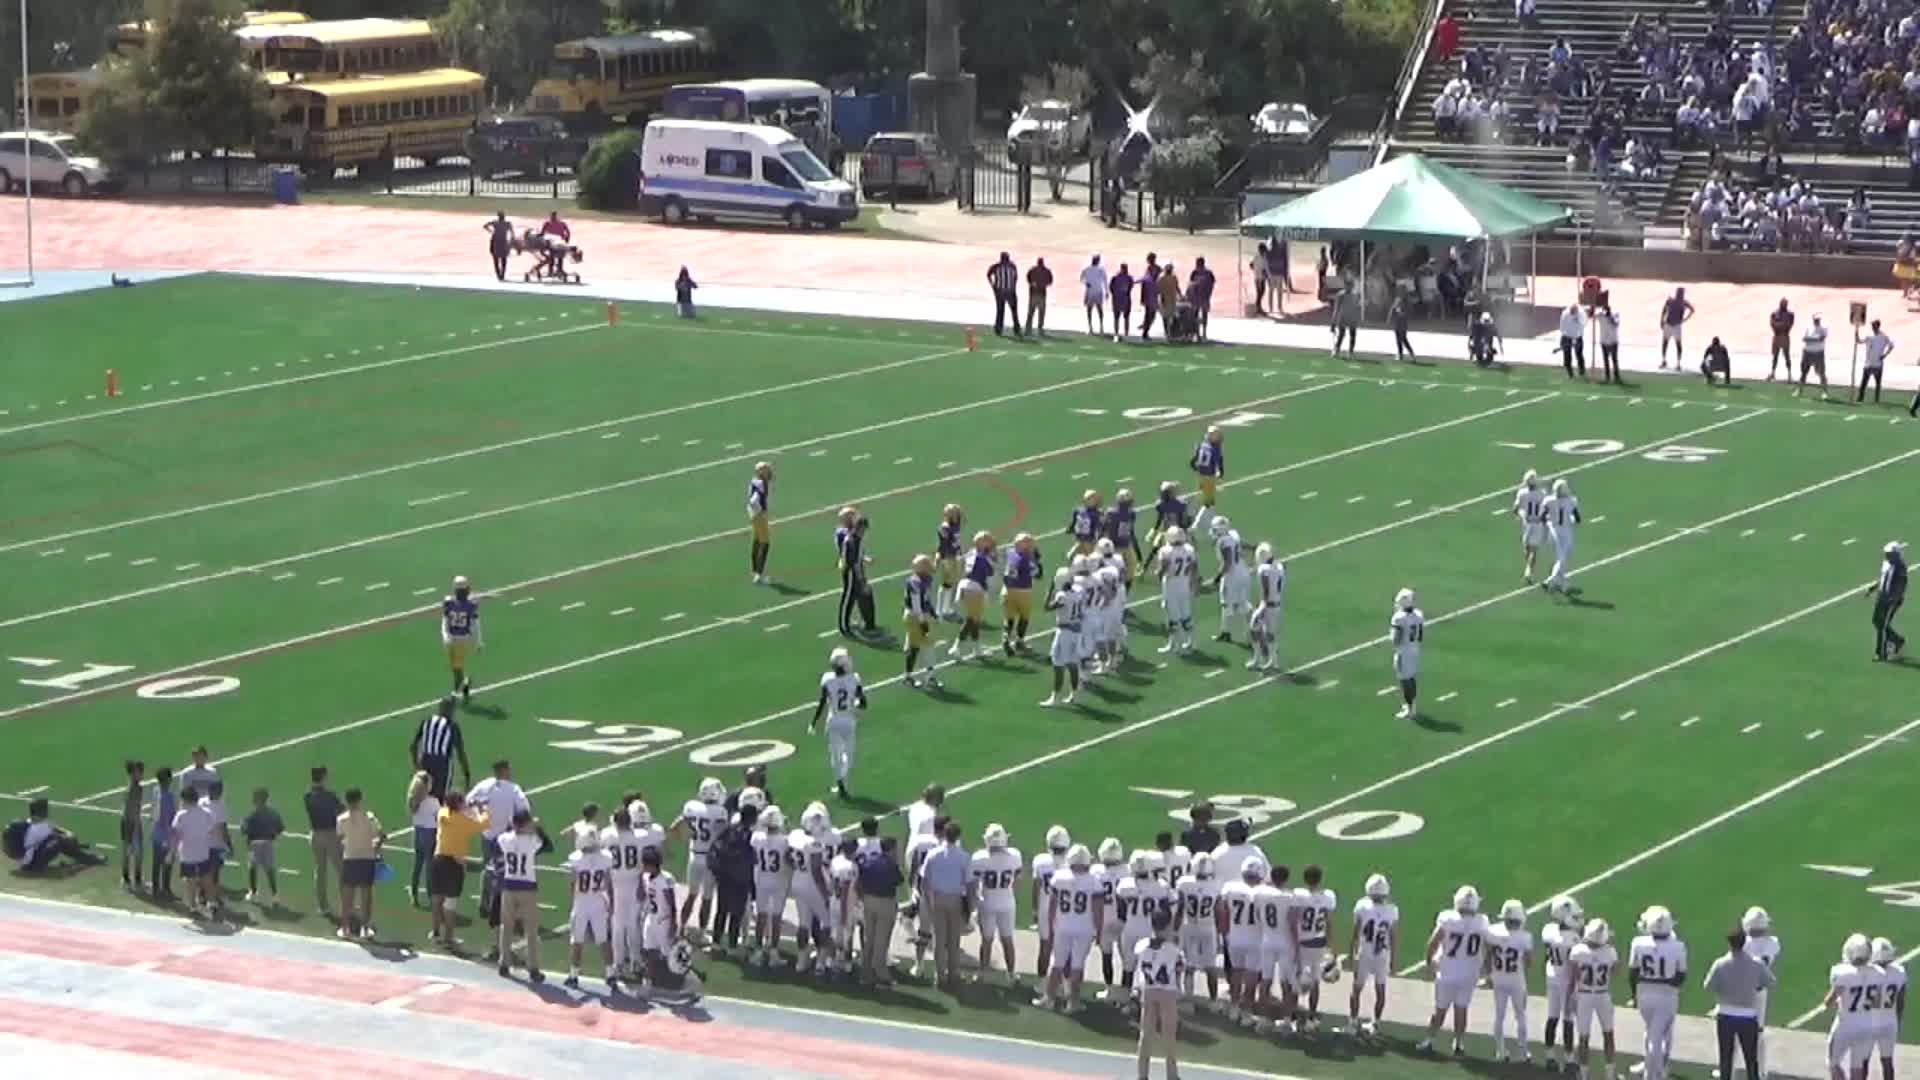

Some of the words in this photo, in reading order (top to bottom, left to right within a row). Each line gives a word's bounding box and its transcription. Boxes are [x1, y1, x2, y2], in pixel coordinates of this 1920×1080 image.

[837, 688, 849, 711] 2
[505, 853, 527, 875] 91
[756, 849, 781, 874] 13
[1059, 888, 1088, 914] 69
[1186, 894, 1213, 918] 32
[1231, 899, 1257, 925] 71
[1299, 906, 1327, 933] 92
[1447, 932, 1482, 958] 70
[1640, 955, 1666, 979] 61
